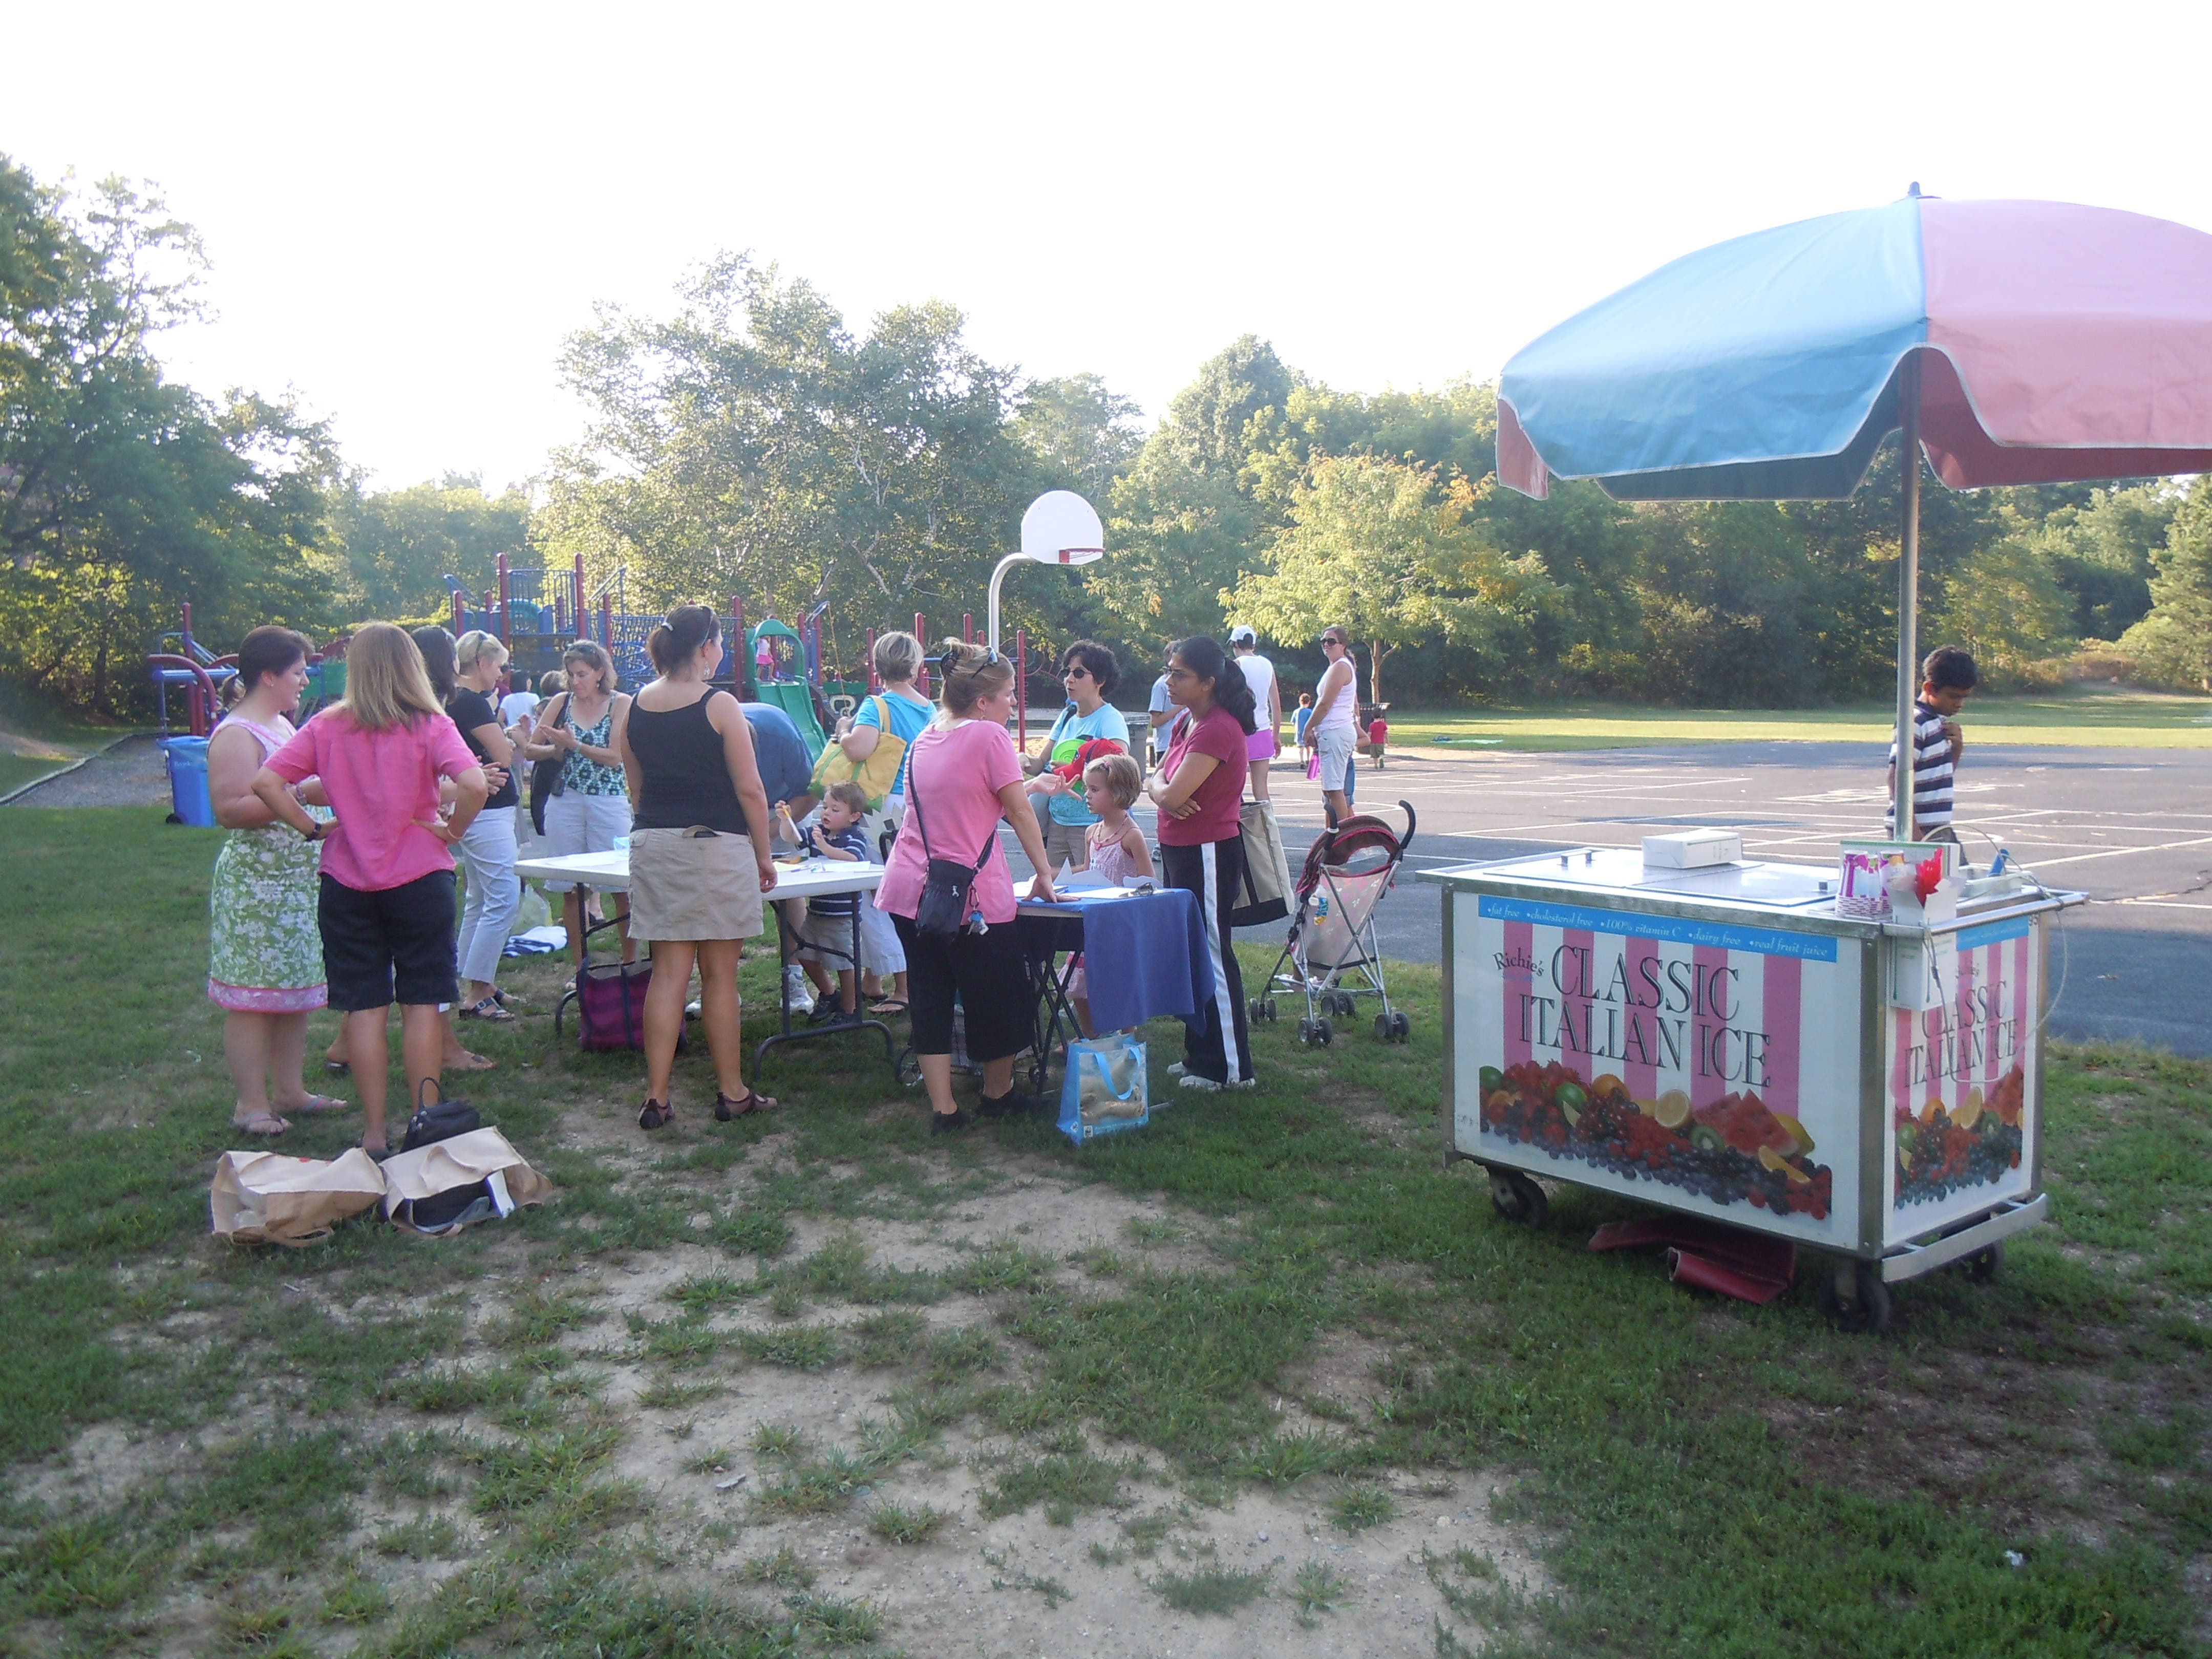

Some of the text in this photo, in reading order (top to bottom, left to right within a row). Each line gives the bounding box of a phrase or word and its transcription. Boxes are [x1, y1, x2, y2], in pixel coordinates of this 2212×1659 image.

[1491, 903, 1828, 956] fat free cholesterol free 100% vitamin C dairy free real fruit juice
[1493, 947, 1545, 977] Richie's
[1551, 945, 1740, 1021] CLASSIC
[1519, 994, 1771, 1088] ITALIAN ICE
[1904, 1018, 2018, 1088] ITALIAN ICE
